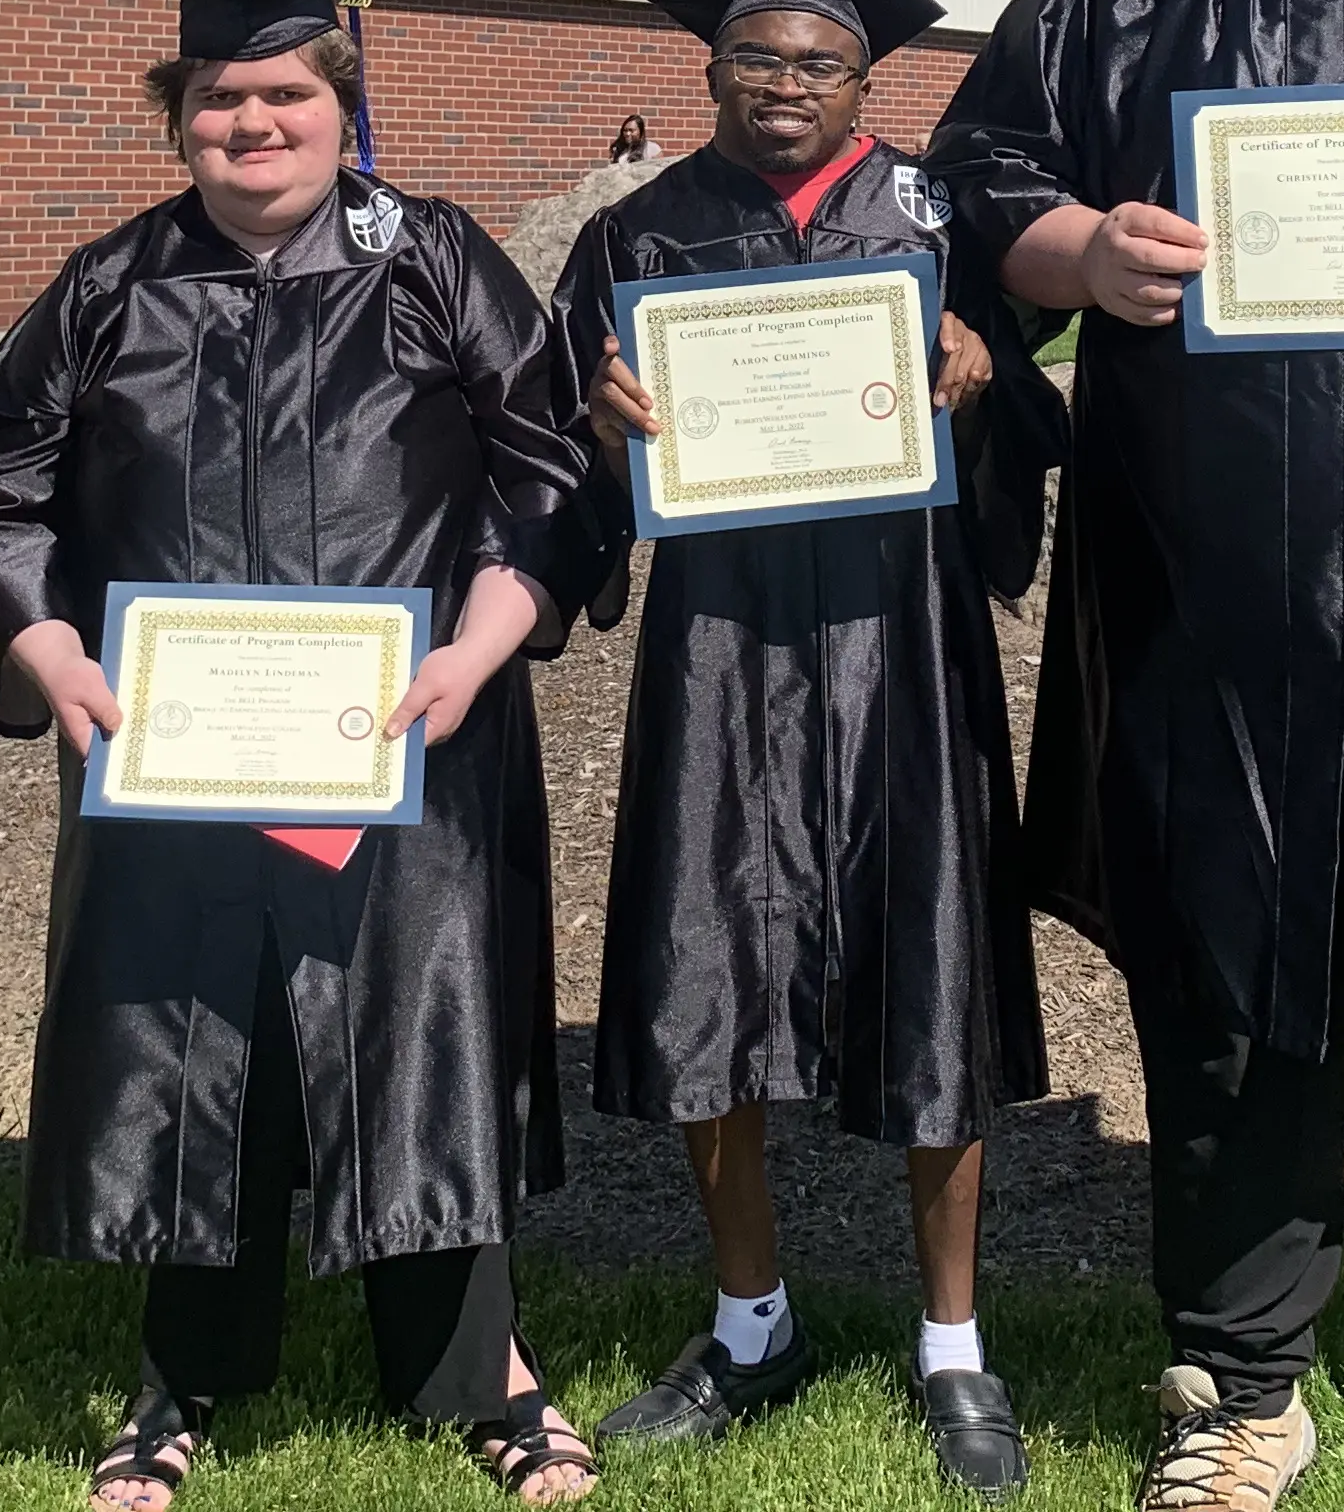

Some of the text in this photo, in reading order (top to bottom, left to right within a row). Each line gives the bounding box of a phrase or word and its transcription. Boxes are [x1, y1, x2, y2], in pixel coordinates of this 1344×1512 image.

[1240, 140, 1303, 152] Certificate
[1306, 138, 1320, 149] of
[1276, 172, 1338, 183] CHRISTIAN
[679, 313, 873, 340] Certificate of Program Completion
[731, 350, 830, 367] AARON CUMMINGS
[167, 634, 362, 650] Certificate of Program Completion
